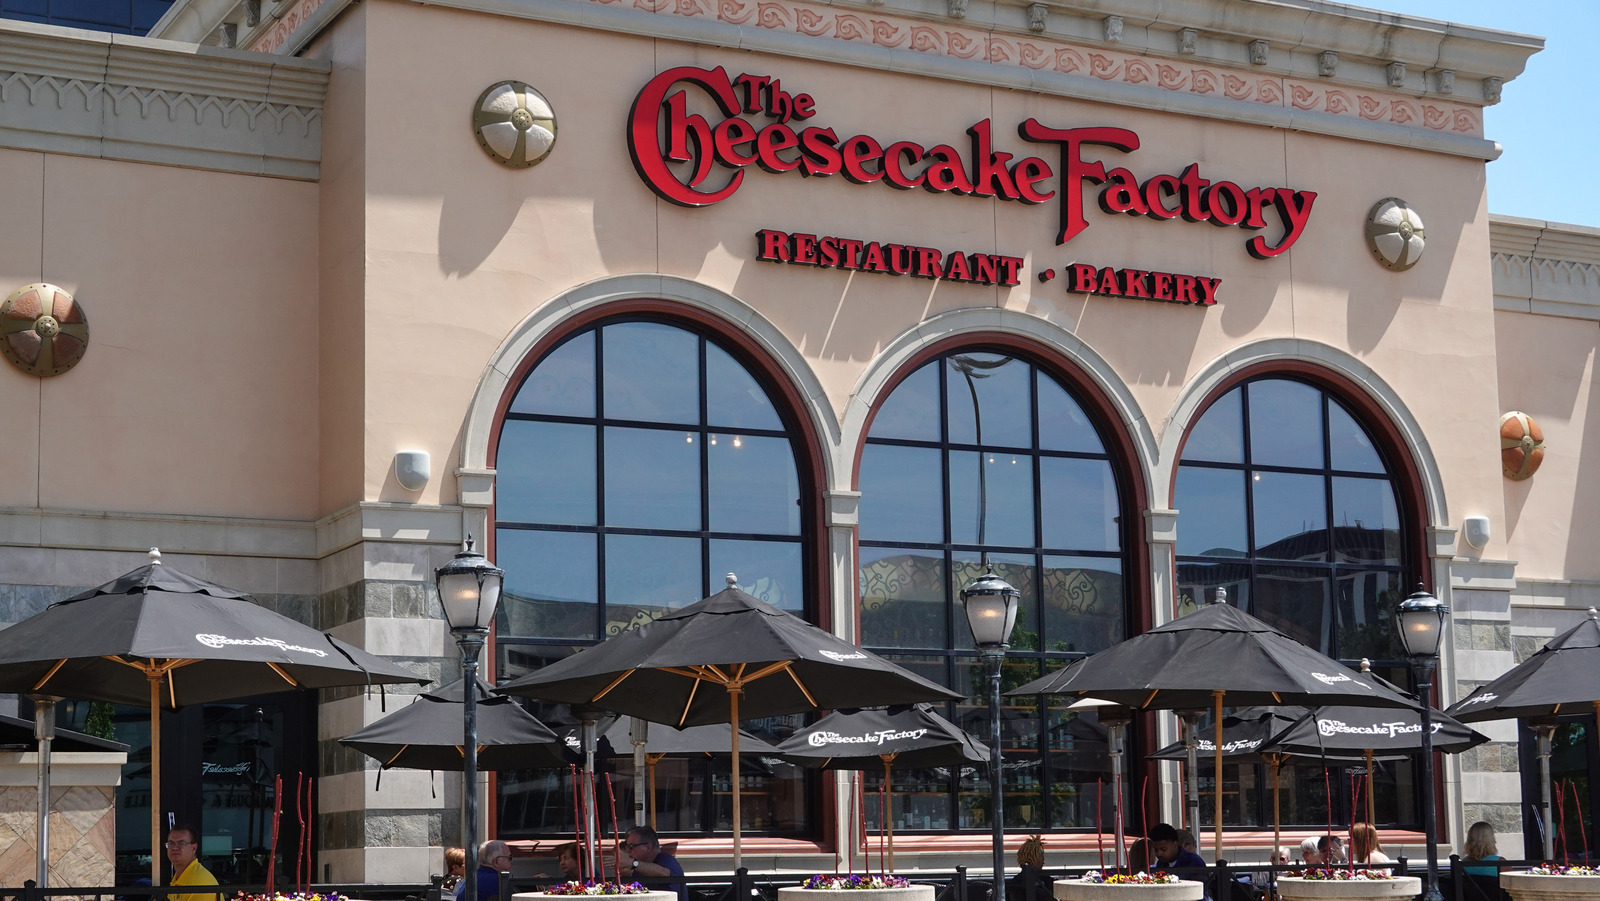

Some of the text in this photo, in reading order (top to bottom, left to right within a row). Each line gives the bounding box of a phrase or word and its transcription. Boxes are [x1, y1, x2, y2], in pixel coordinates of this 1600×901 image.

[732, 73, 816, 124] The
[627, 65, 1318, 259] Cheesecake Factory
[756, 228, 1222, 306] RESTAURANT BAKERY
[808, 728, 928, 747] Cheesecake Factory
[1317, 719, 1443, 738] Cheesecake Facty
